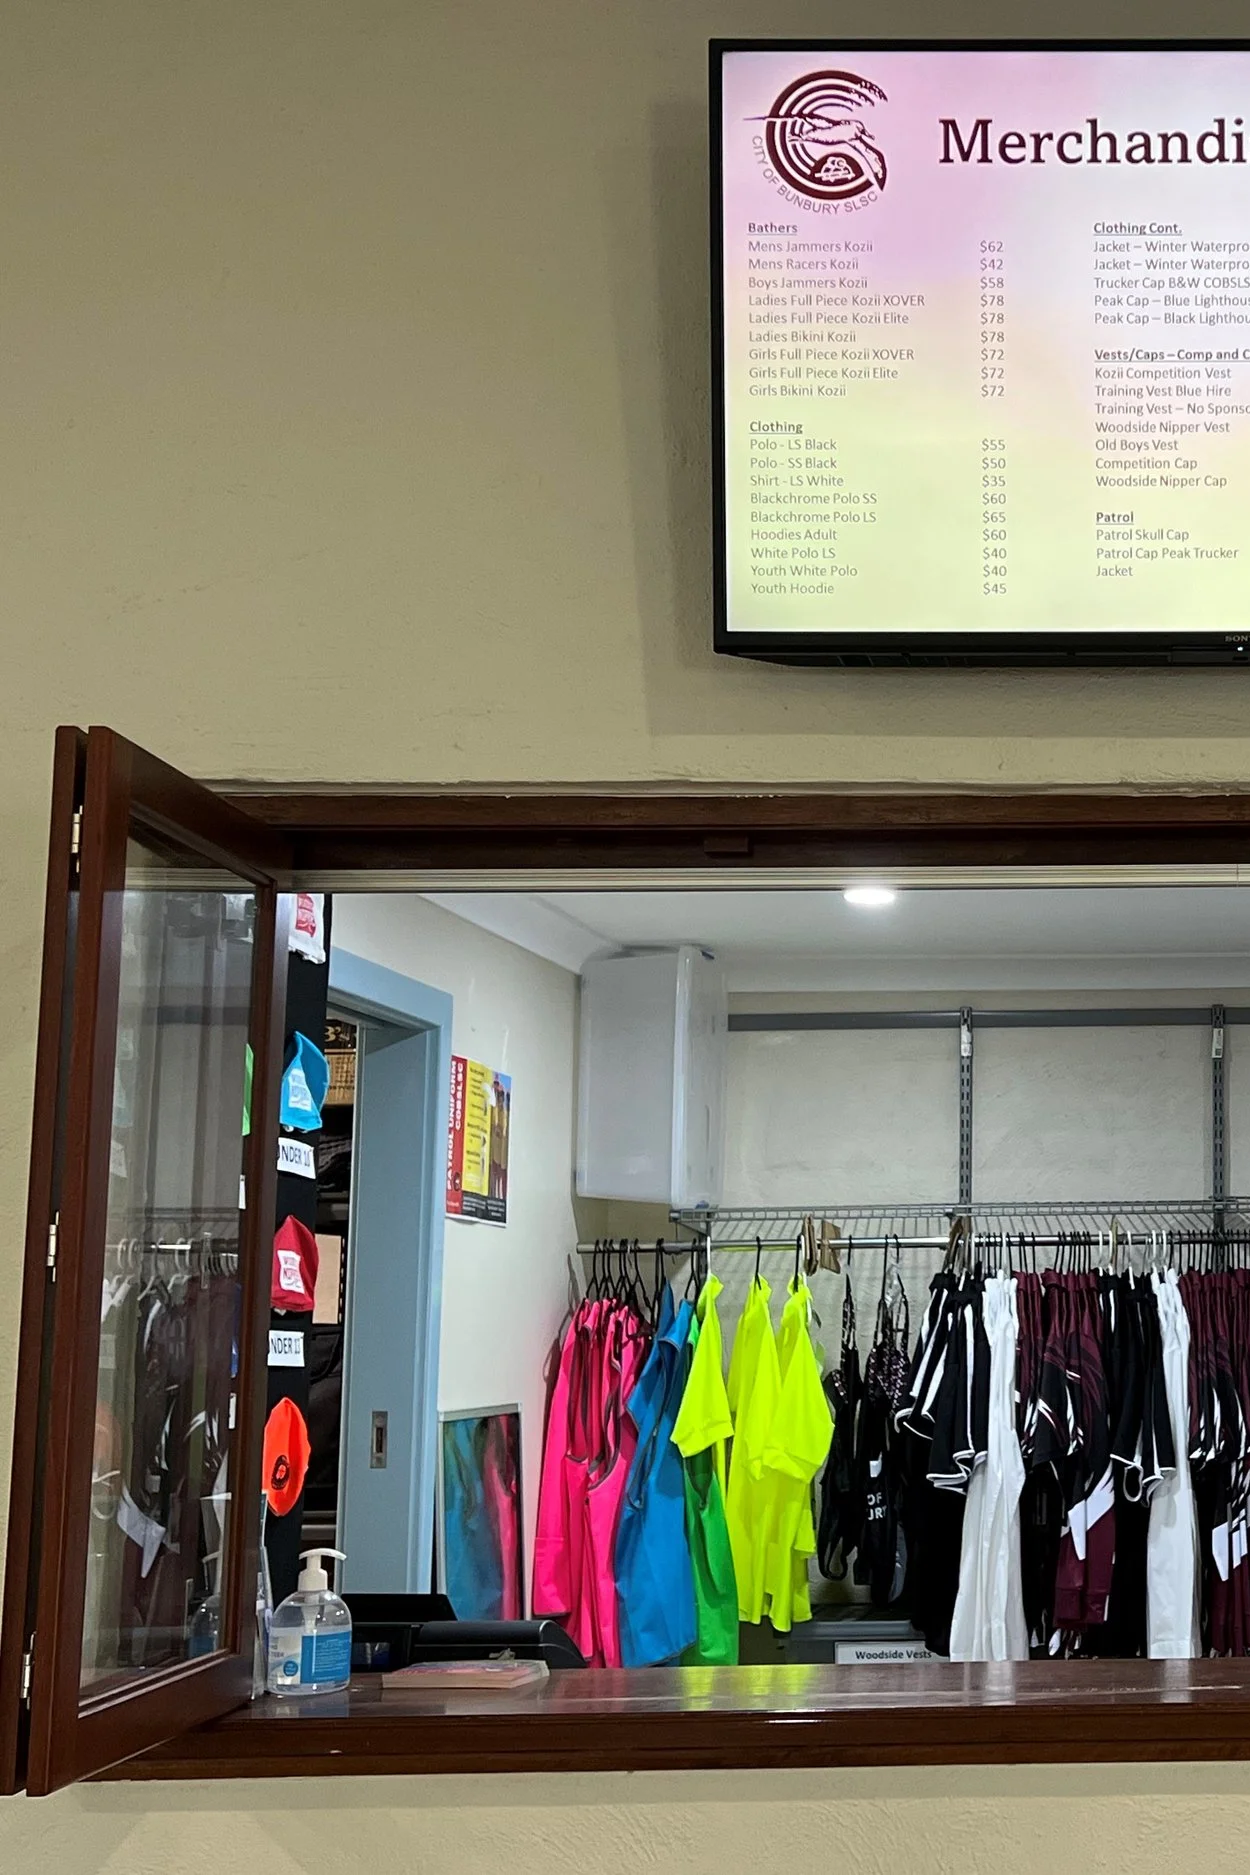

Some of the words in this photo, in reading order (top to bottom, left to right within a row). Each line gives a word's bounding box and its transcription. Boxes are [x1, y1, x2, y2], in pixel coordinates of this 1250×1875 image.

[752, 135, 769, 166] CITY
[763, 168, 780, 185] OF
[777, 184, 840, 214] BUNBURY
[844, 191, 878, 213] SLSC
[748, 222, 798, 236] Bathers
[1094, 222, 1146, 236] Clothing
[1149, 223, 1182, 236] Cont.
[747, 240, 784, 253] Mens
[785, 240, 842, 253] Jammers
[844, 240, 873, 253] Kozii
[980, 240, 1003, 253] $62
[1093, 257, 1132, 271] Jacket
[1144, 257, 1188, 271] Winter
[749, 277, 778, 290] Boys
[779, 275, 837, 289] Jammers
[838, 276, 868, 289] Kozii
[980, 276, 1004, 290] $58
[1093, 276, 1142, 289] Trucker
[1142, 277, 1165, 290] Cap
[1168, 275, 1201, 289] B&W
[748, 293, 788, 307] Ladies
[790, 293, 813, 307] Full
[815, 293, 849, 307] Piece
[851, 293, 881, 307] Kozii
[882, 294, 925, 307] XOVER
[980, 293, 1004, 307] $78
[1095, 348, 1165, 362] Vests/Caps
[1177, 349, 1213, 362] Comp
[1216, 348, 1239, 362] and
[1094, 366, 1124, 380] Kozii
[1126, 367, 1201, 380] Competition
[1204, 366, 1233, 380] Vest
[1095, 384, 1144, 399] Training
[1145, 384, 1174, 397] Vest
[1175, 384, 1203, 397] Blue
[1205, 383, 1232, 397] Hire
[750, 421, 803, 434] Clothing
[1094, 420, 1157, 434] Woodside
[1159, 421, 1201, 435] Nipper
[1203, 420, 1231, 433] Vest
[1094, 437, 1117, 451] Old
[1120, 439, 1150, 452] Boys
[1151, 438, 1180, 451] Vest
[1096, 457, 1170, 471] Competition
[1175, 457, 1197, 470] Cap
[749, 491, 831, 505] Blackchrome
[832, 491, 861, 505] Polo
[861, 492, 878, 505] SS
[982, 492, 1006, 505] $60
[1096, 511, 1133, 524] Patrol
[750, 527, 802, 541] Hoodies
[803, 527, 839, 541] Adult
[983, 529, 1006, 542] $60
[1095, 528, 1133, 541] Patrol
[1134, 528, 1164, 541] Skull
[1166, 529, 1189, 542] Cap
[750, 546, 789, 560] White
[791, 546, 820, 560] Polo
[821, 546, 837, 560] LS
[983, 547, 1008, 560] $40
[1096, 546, 1133, 560] Patrol
[1134, 547, 1159, 561] Cap
[1161, 546, 1192, 560] Peak
[1192, 547, 1240, 559] Trucker
[749, 564, 787, 577] Youth
[788, 563, 828, 577] White
[830, 564, 858, 577] Polo
[983, 564, 1007, 578] $40
[1095, 564, 1134, 577] Jacket
[270, 1337, 293, 1355] NDER
[855, 1649, 904, 1660] Woodside
[906, 1649, 932, 1659] Vests
